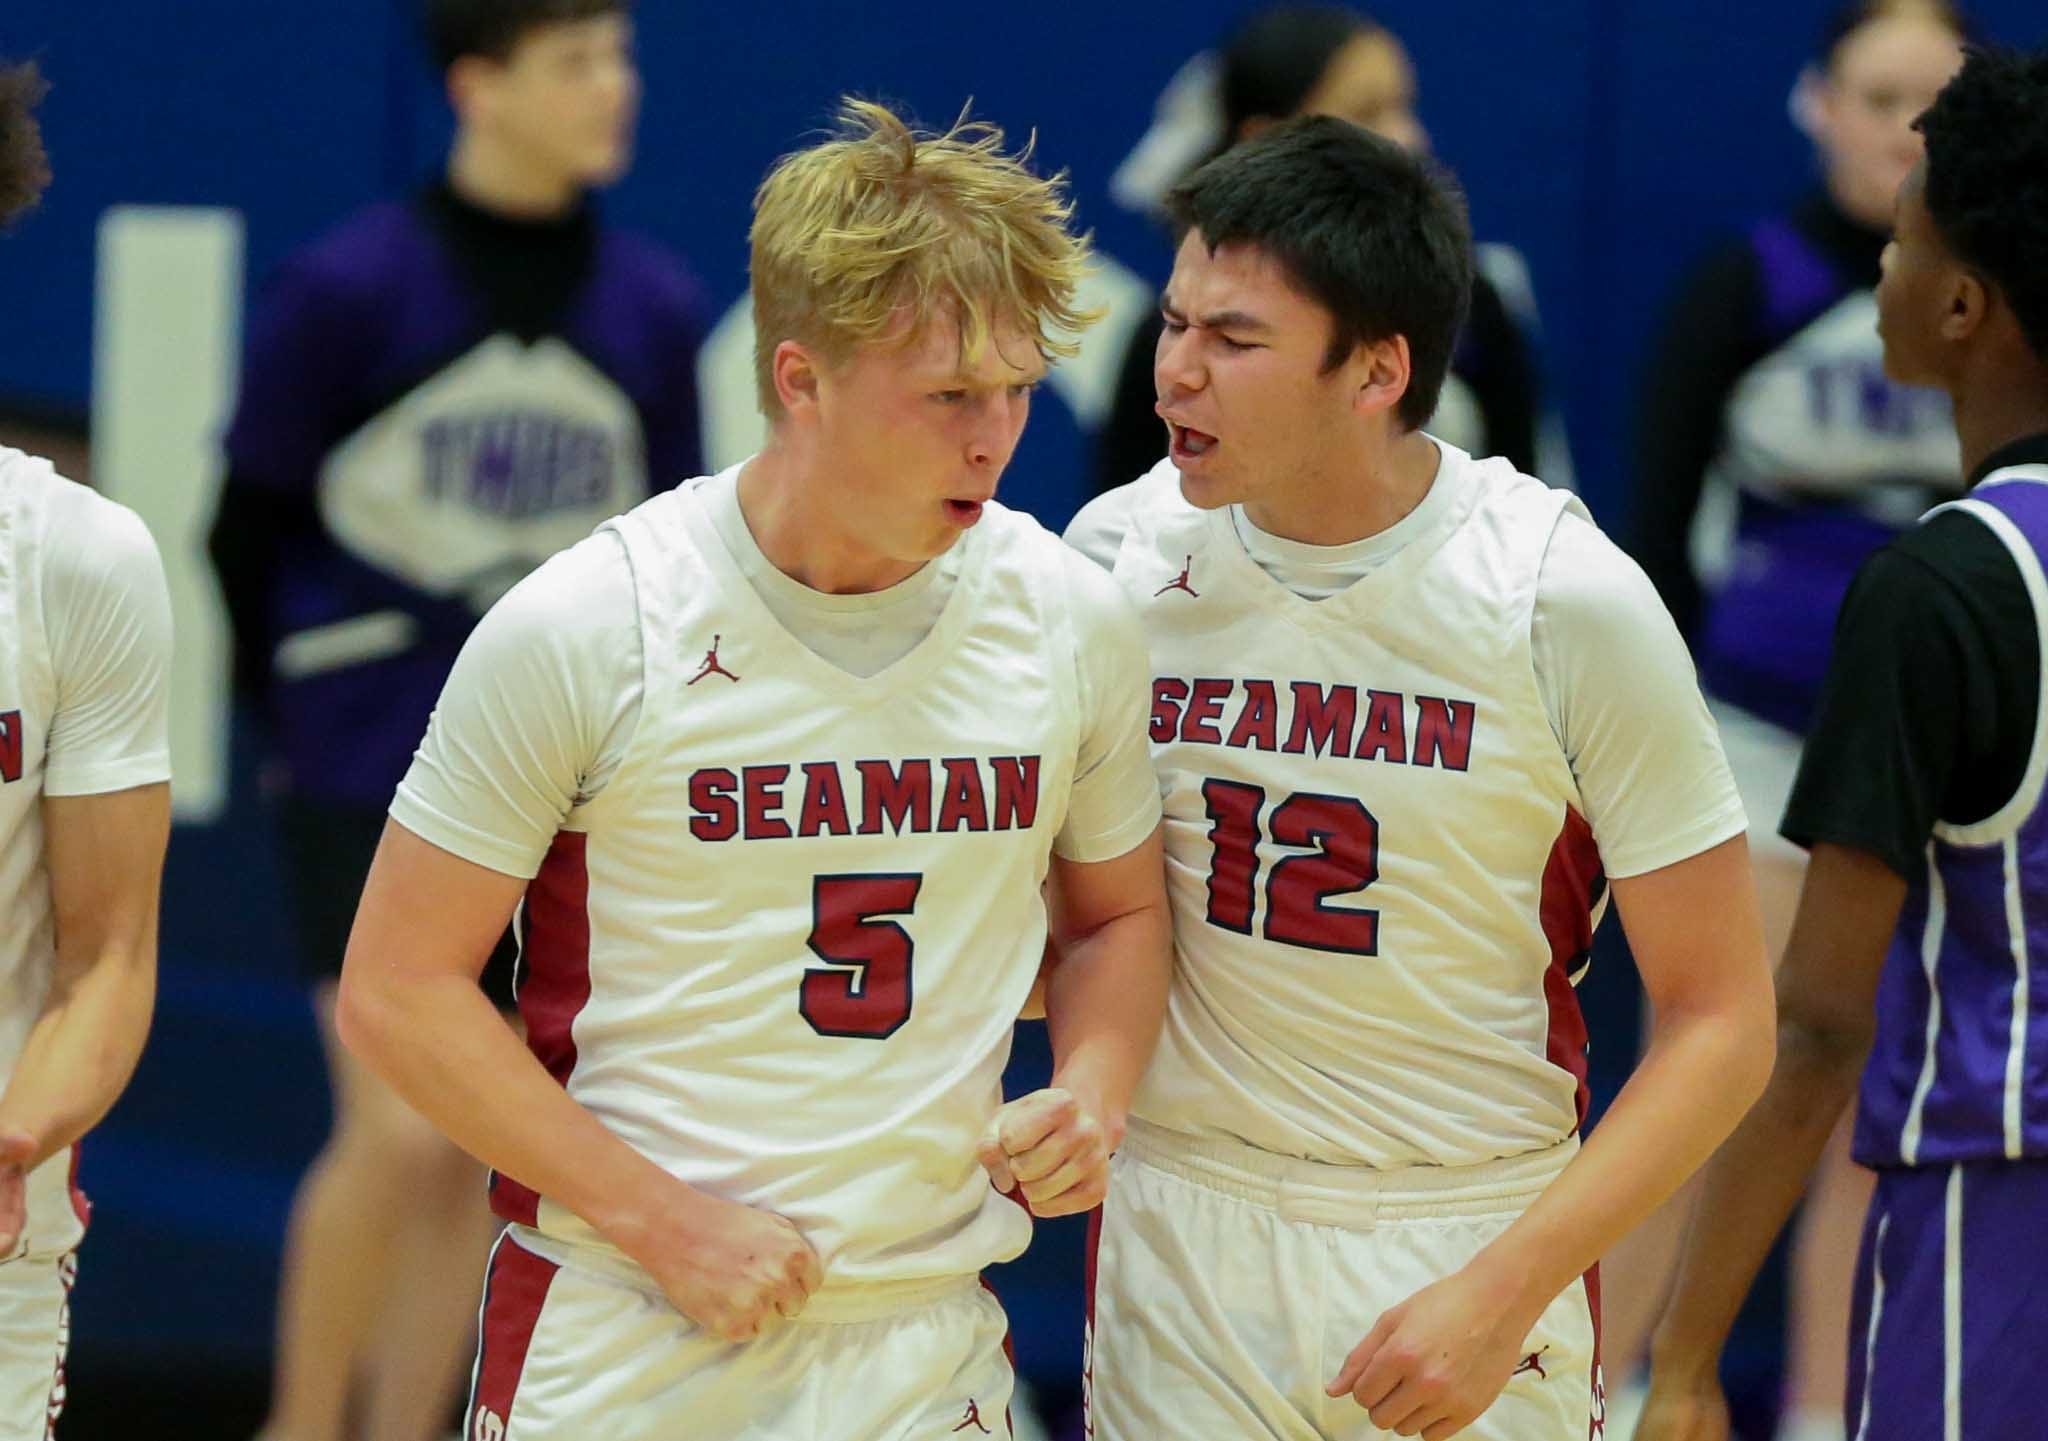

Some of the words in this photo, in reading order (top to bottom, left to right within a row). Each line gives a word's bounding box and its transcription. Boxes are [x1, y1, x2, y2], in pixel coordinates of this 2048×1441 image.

[1148, 677, 1476, 772] SEAMAN
[688, 755, 1041, 842] SEAMAN
[1201, 777, 1380, 957] 12
[798, 872, 924, 1040] 5
